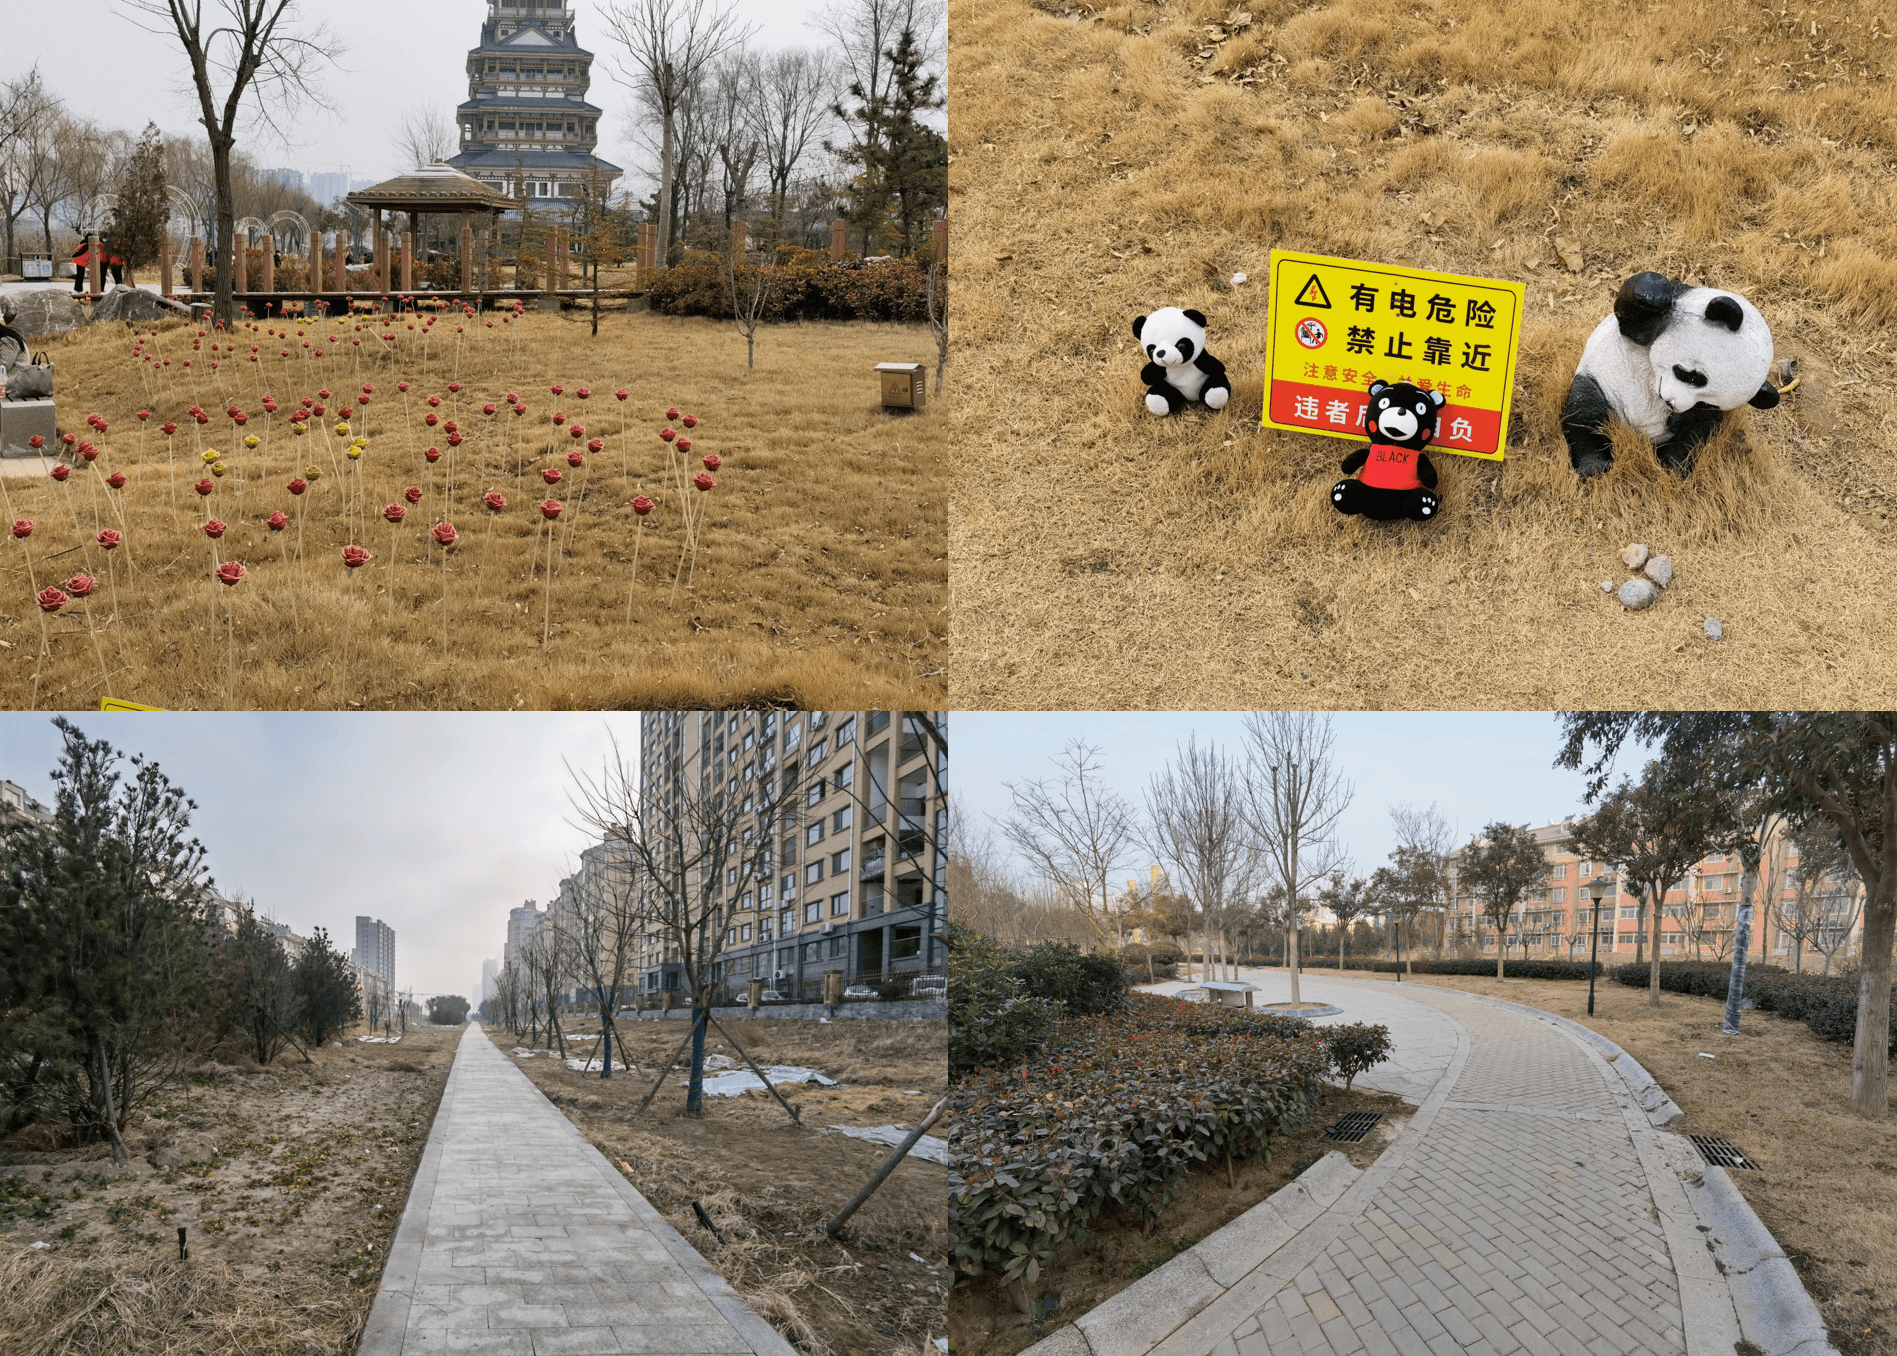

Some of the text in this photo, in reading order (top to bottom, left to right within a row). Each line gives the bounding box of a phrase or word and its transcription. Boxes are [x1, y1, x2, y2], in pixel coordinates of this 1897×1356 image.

[1349, 282, 1497, 330] 有电危险
[1346, 325, 1492, 372] 禁止靠近
[1303, 362, 1378, 387] 注意安全
[1376, 450, 1410, 465] BLACK
